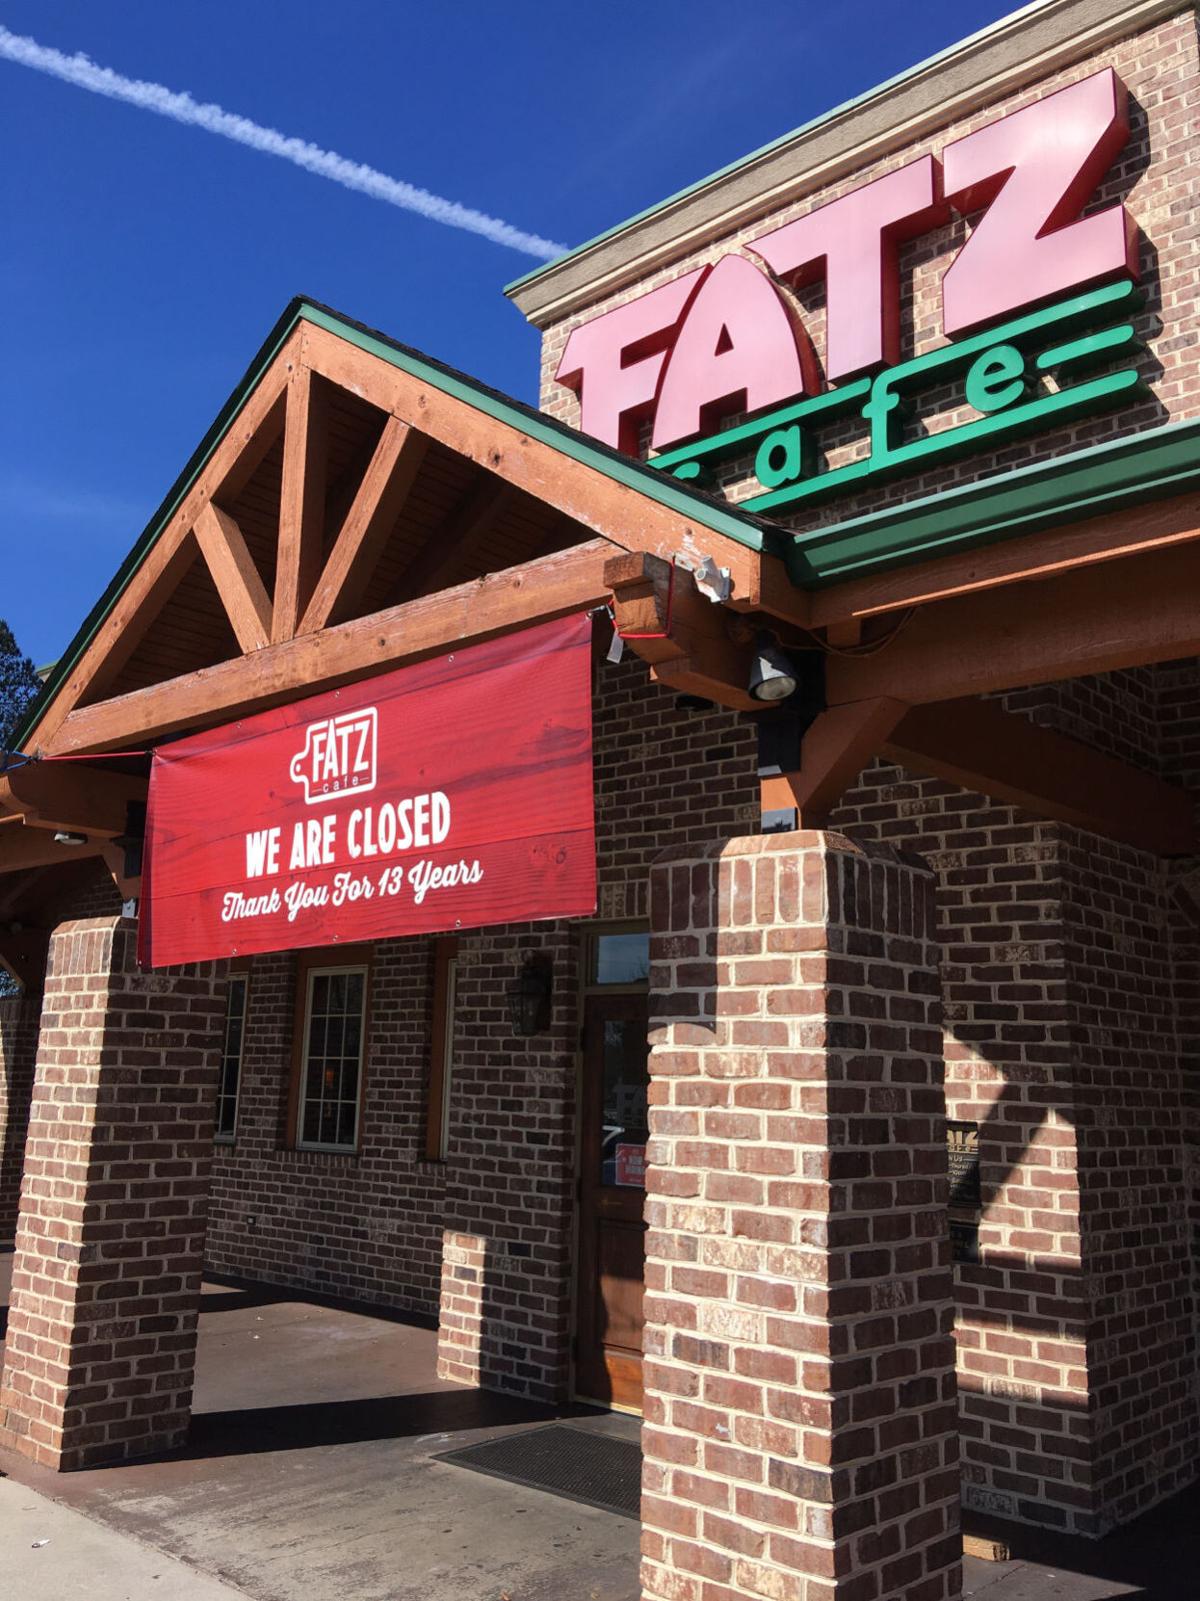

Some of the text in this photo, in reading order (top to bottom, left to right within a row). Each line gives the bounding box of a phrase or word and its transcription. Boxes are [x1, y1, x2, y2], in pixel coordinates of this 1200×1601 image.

[555, 66, 1134, 456] FATZ
[672, 344, 1025, 488] afe
[312, 719, 371, 783] FATZ
[322, 776, 359, 793] cafe
[246, 791, 451, 879] WE ARE CLOSED
[221, 860, 484, 922] Thank You For 13 Years
